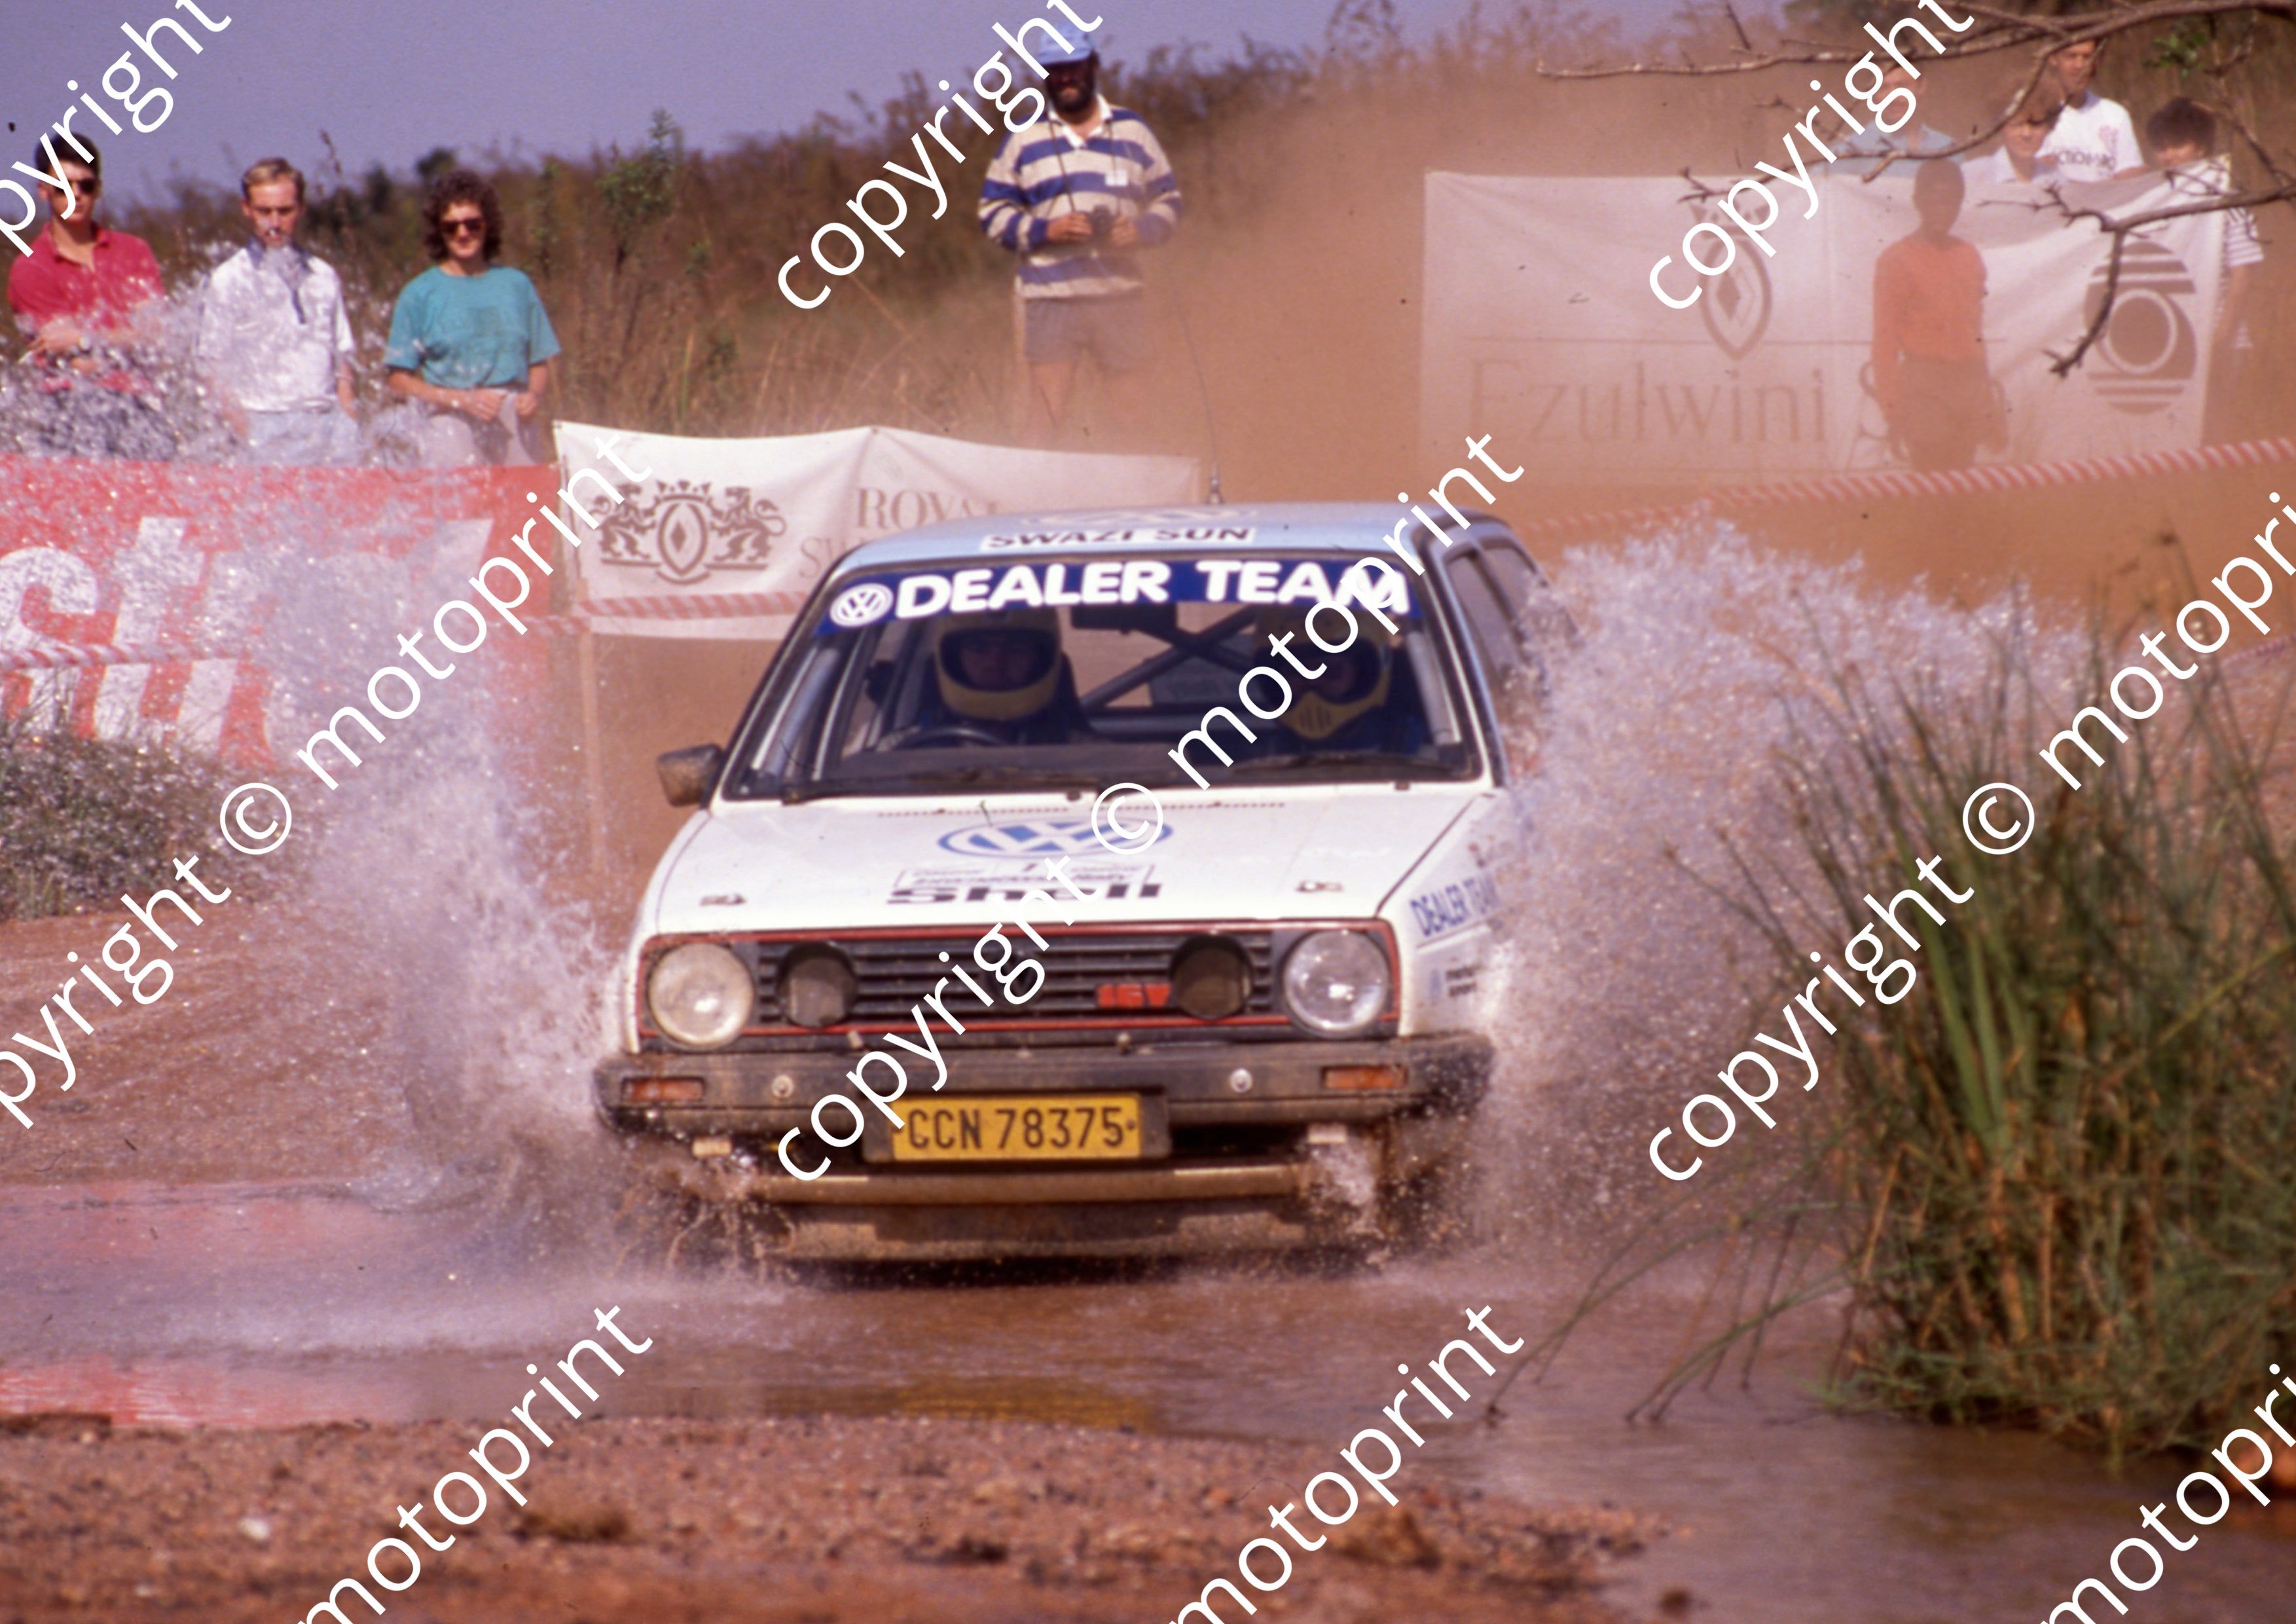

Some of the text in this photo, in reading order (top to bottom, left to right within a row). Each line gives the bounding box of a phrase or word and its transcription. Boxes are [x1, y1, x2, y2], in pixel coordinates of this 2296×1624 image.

[989, 527, 1250, 549] SWAZI SUN
[894, 561, 1171, 619] DEALER
[1194, 559, 1410, 614] TEAM
[886, 883, 1162, 905] Shell
[906, 1105, 1123, 1151] CCN 78375
